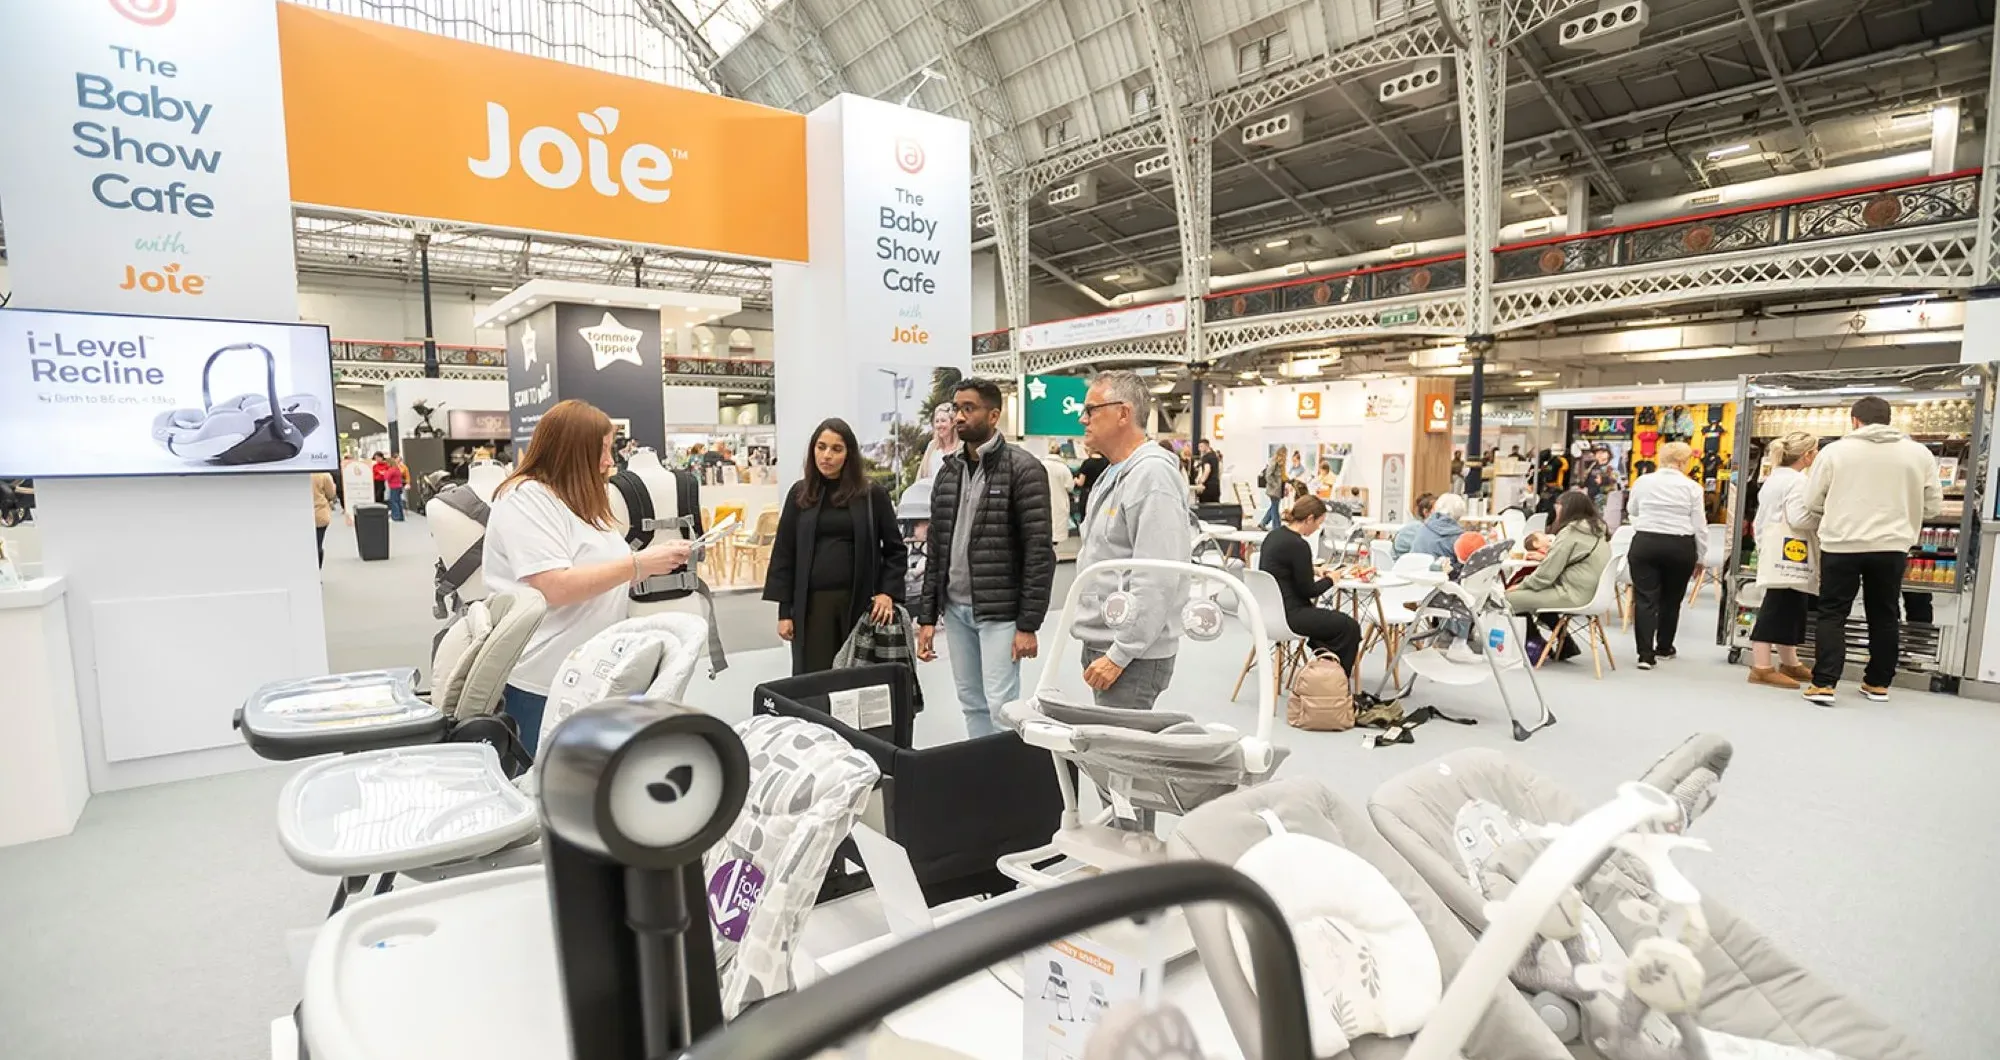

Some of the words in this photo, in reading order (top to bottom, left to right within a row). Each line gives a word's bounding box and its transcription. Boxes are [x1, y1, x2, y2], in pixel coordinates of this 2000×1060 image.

[109, 44, 177, 78] The
[76, 72, 213, 134] Baby
[73, 121, 221, 173] Show
[468, 101, 673, 204] Joie
[92, 173, 214, 218] Cafe
[895, 187, 924, 206] The
[880, 206, 938, 241] Baby
[135, 231, 188, 254] with
[876, 236, 941, 265] Show
[120, 263, 204, 295] Joie
[883, 268, 936, 294] Cafe
[27, 331, 146, 358] i-Level
[588, 331, 637, 342] tommee
[891, 324, 929, 344] Joie
[595, 342, 633, 355] tippee
[31, 359, 164, 385] Recline
[55, 394, 83, 404] Birth
[86, 395, 98, 404] to
